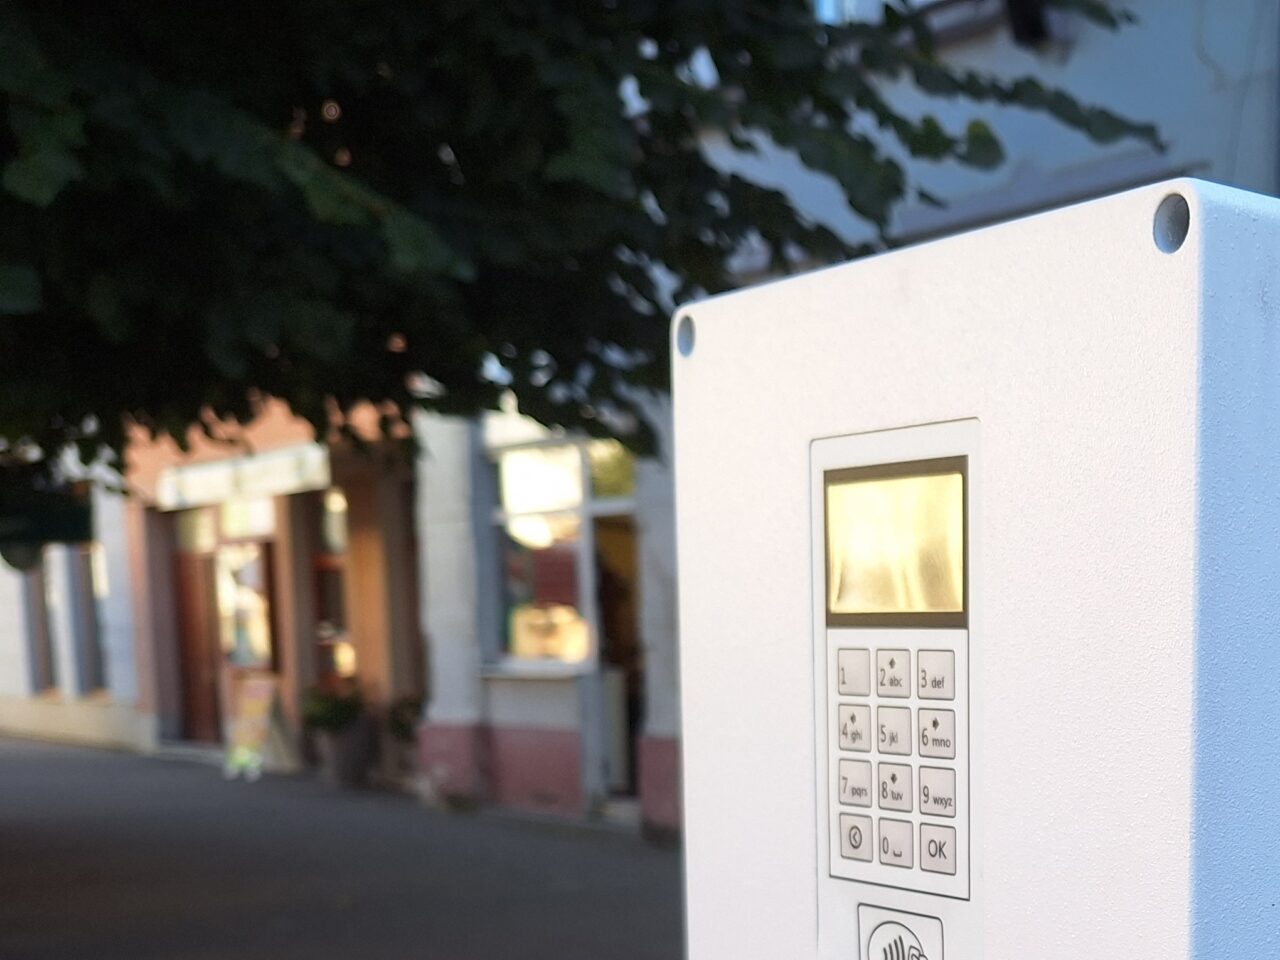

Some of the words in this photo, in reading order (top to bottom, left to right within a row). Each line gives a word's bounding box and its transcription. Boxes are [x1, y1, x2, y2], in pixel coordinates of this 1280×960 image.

[840, 667, 847, 686] 1
[880, 668, 886, 687] 2
[889, 676, 903, 688] abc
[921, 669, 927, 688] 3
[931, 676, 945, 689] def
[841, 722, 848, 739] 4
[851, 730, 862, 744] ghi
[880, 725, 886, 743] 5
[888, 732, 899, 746] jkl
[922, 728, 928, 747] 6
[932, 738, 951, 749] mno
[842, 776, 848, 794] 7
[851, 786, 868, 798] pqrs
[881, 781, 888, 800] 8
[891, 788, 904, 801] tuv
[922, 785, 930, 804] 9
[933, 796, 953, 808] wxyz
[882, 836, 889, 855] 0
[928, 838, 947, 860] OK
